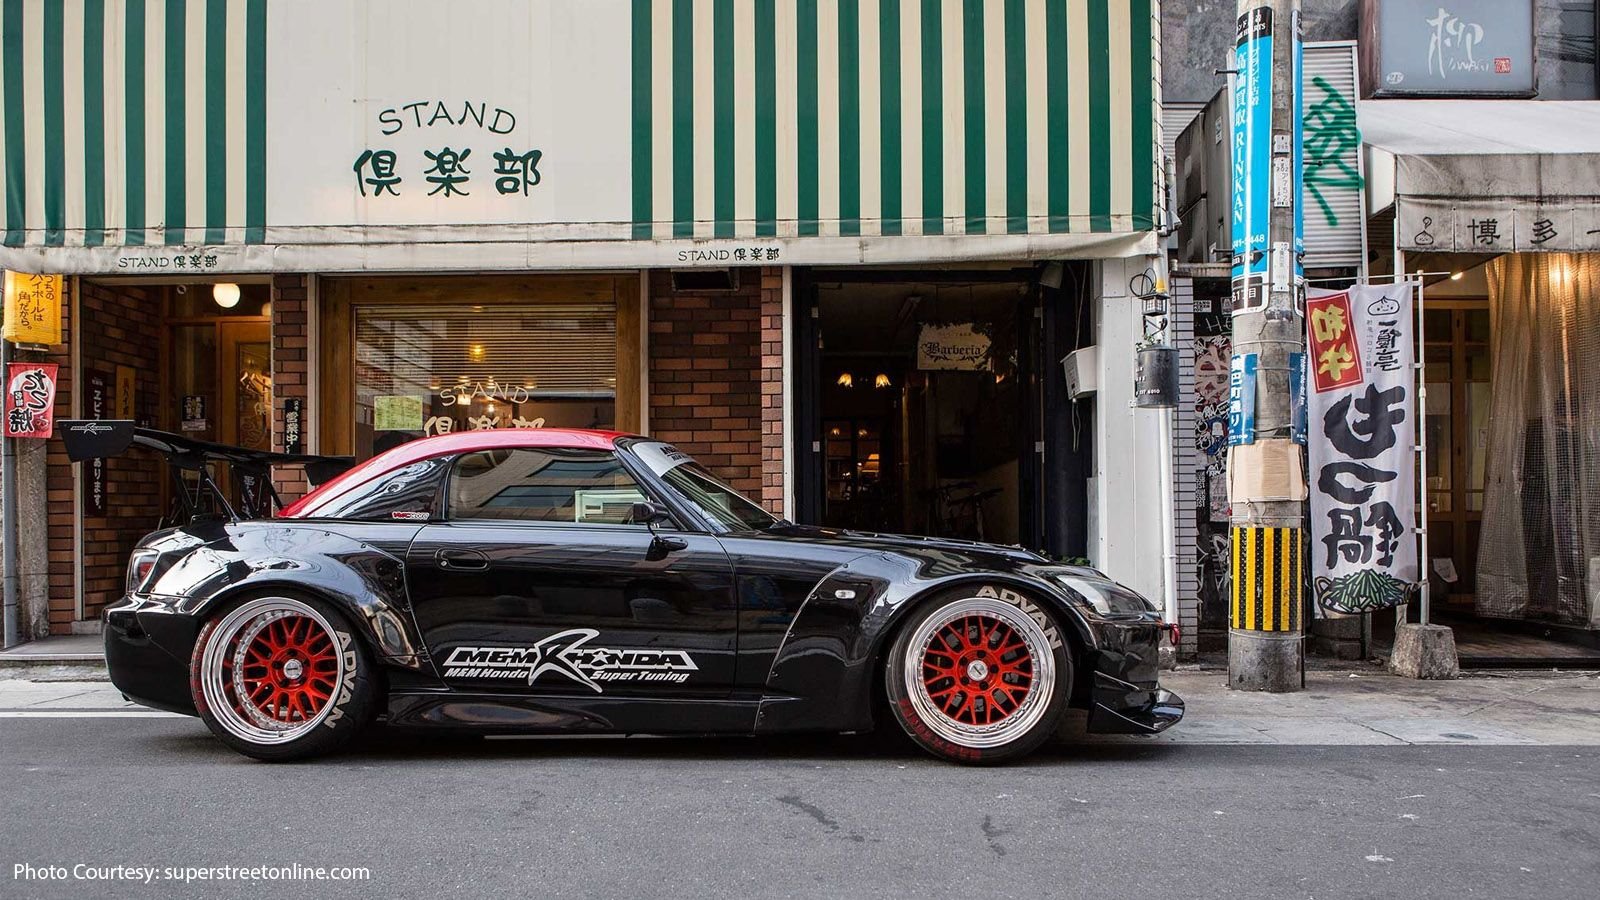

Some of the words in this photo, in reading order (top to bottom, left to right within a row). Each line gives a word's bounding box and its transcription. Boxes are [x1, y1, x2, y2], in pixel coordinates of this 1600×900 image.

[379, 101, 516, 135] STAND
[353, 147, 543, 197] 倶楽部
[1234, 132, 1245, 225] RINKAN
[118, 257, 170, 268] STAND
[173, 255, 218, 268] 倶楽部
[677, 250, 731, 262] STAND
[733, 248, 780, 262] 倶楽部
[926, 341, 981, 355] Barberia
[440, 382, 529, 406] STAND
[976, 585, 1063, 650] ADVAN
[323, 630, 358, 730] ADVAN
[444, 668, 480, 678] M&M
[480, 668, 528, 679] Honda
[590, 670, 638, 681] Super
[638, 671, 690, 683] Tuning
